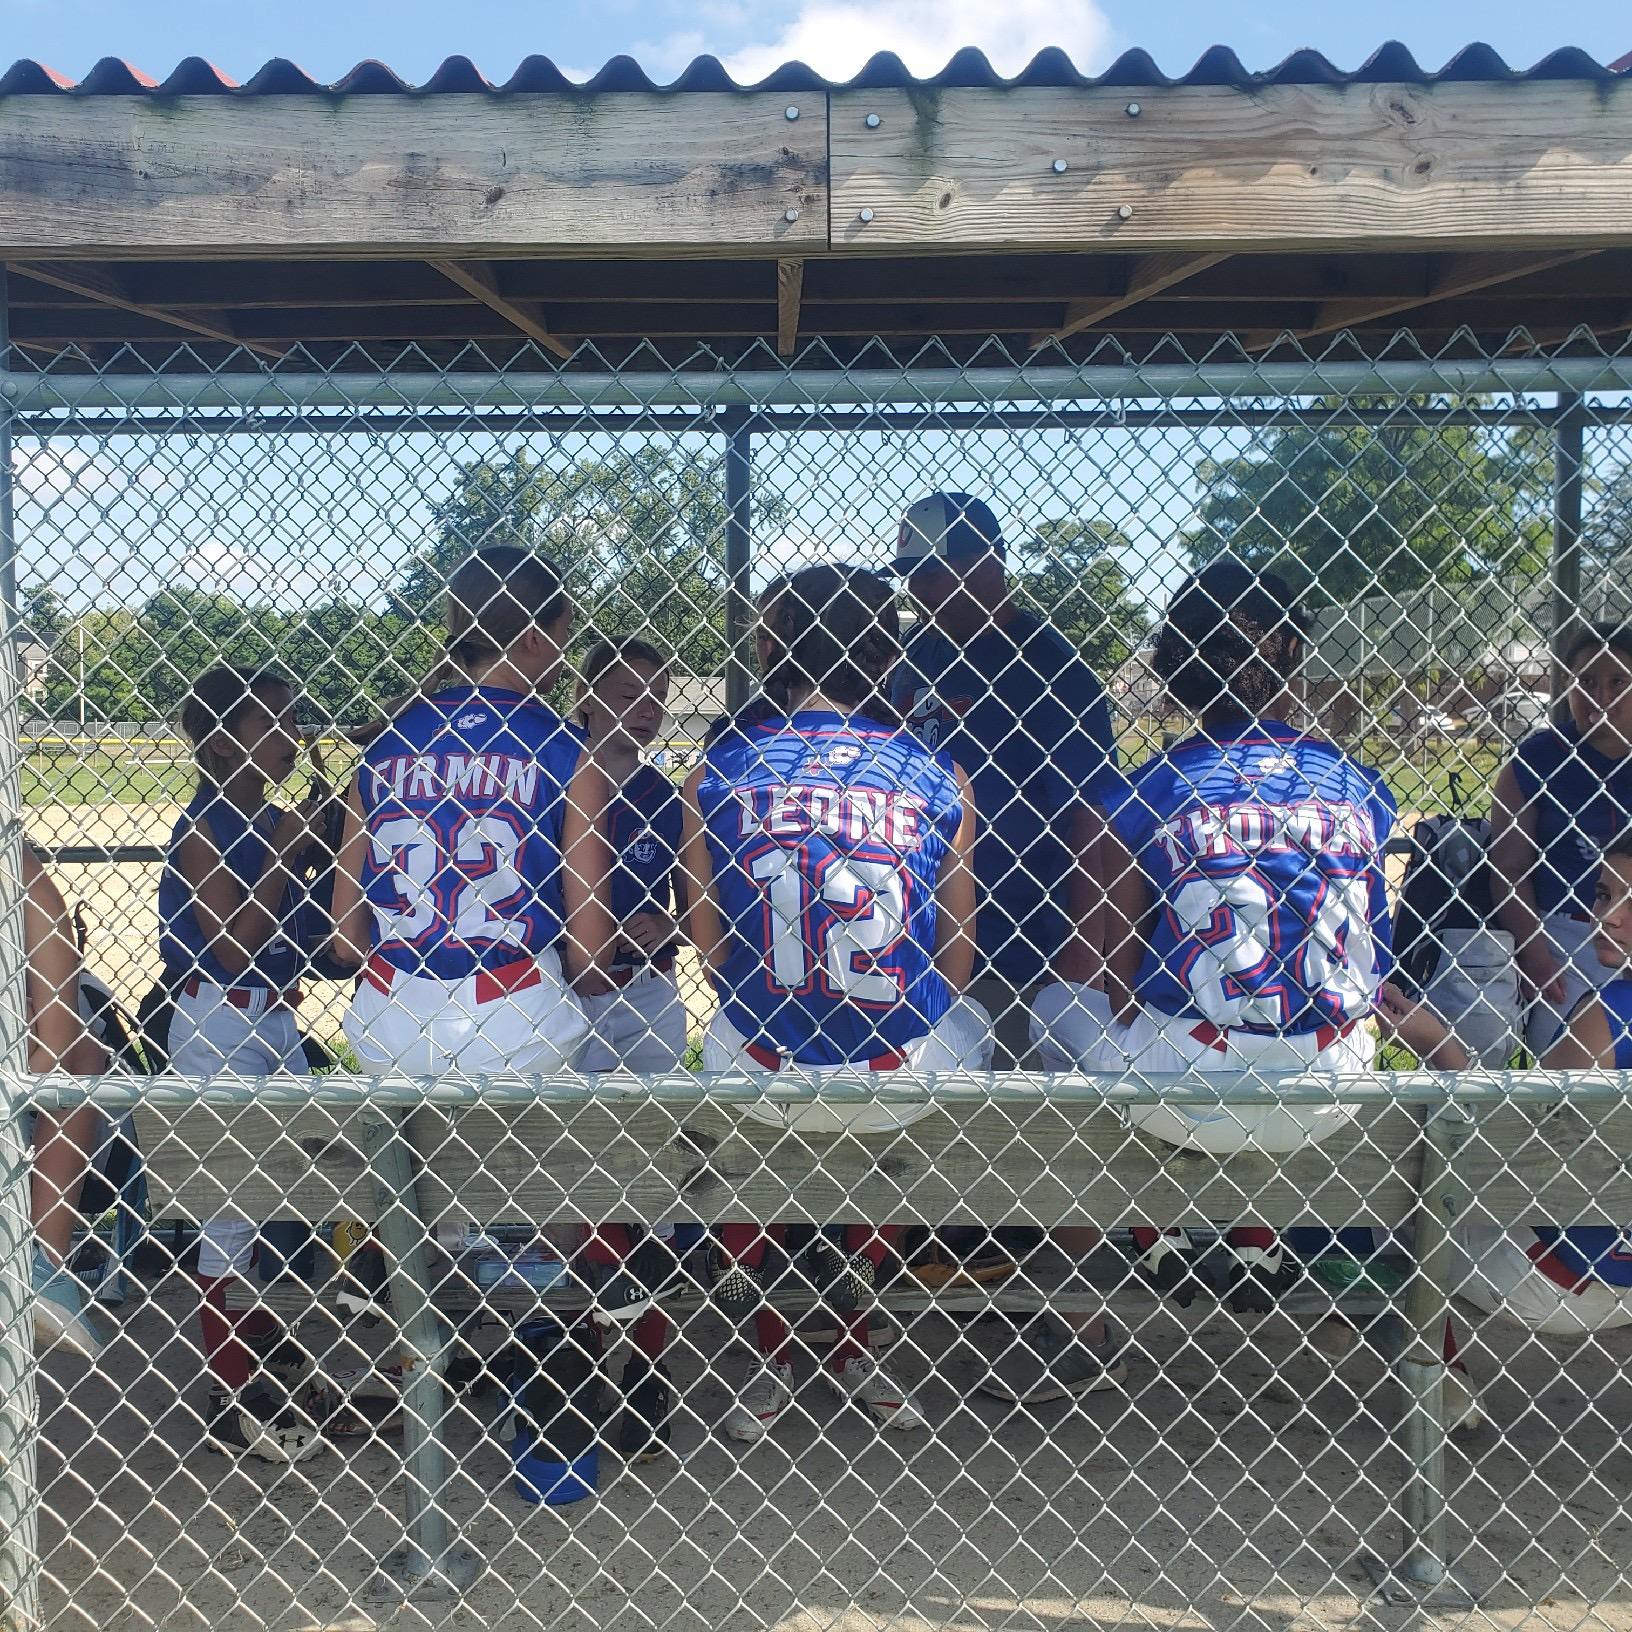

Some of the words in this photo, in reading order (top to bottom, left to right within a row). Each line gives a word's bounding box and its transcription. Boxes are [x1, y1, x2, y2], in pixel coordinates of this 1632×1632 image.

[370, 754, 539, 807] FIRMIN
[736, 785, 923, 850] LEONE
[369, 812, 531, 950] 32
[747, 845, 909, 1005] 12
[1169, 869, 1382, 1025] 24
